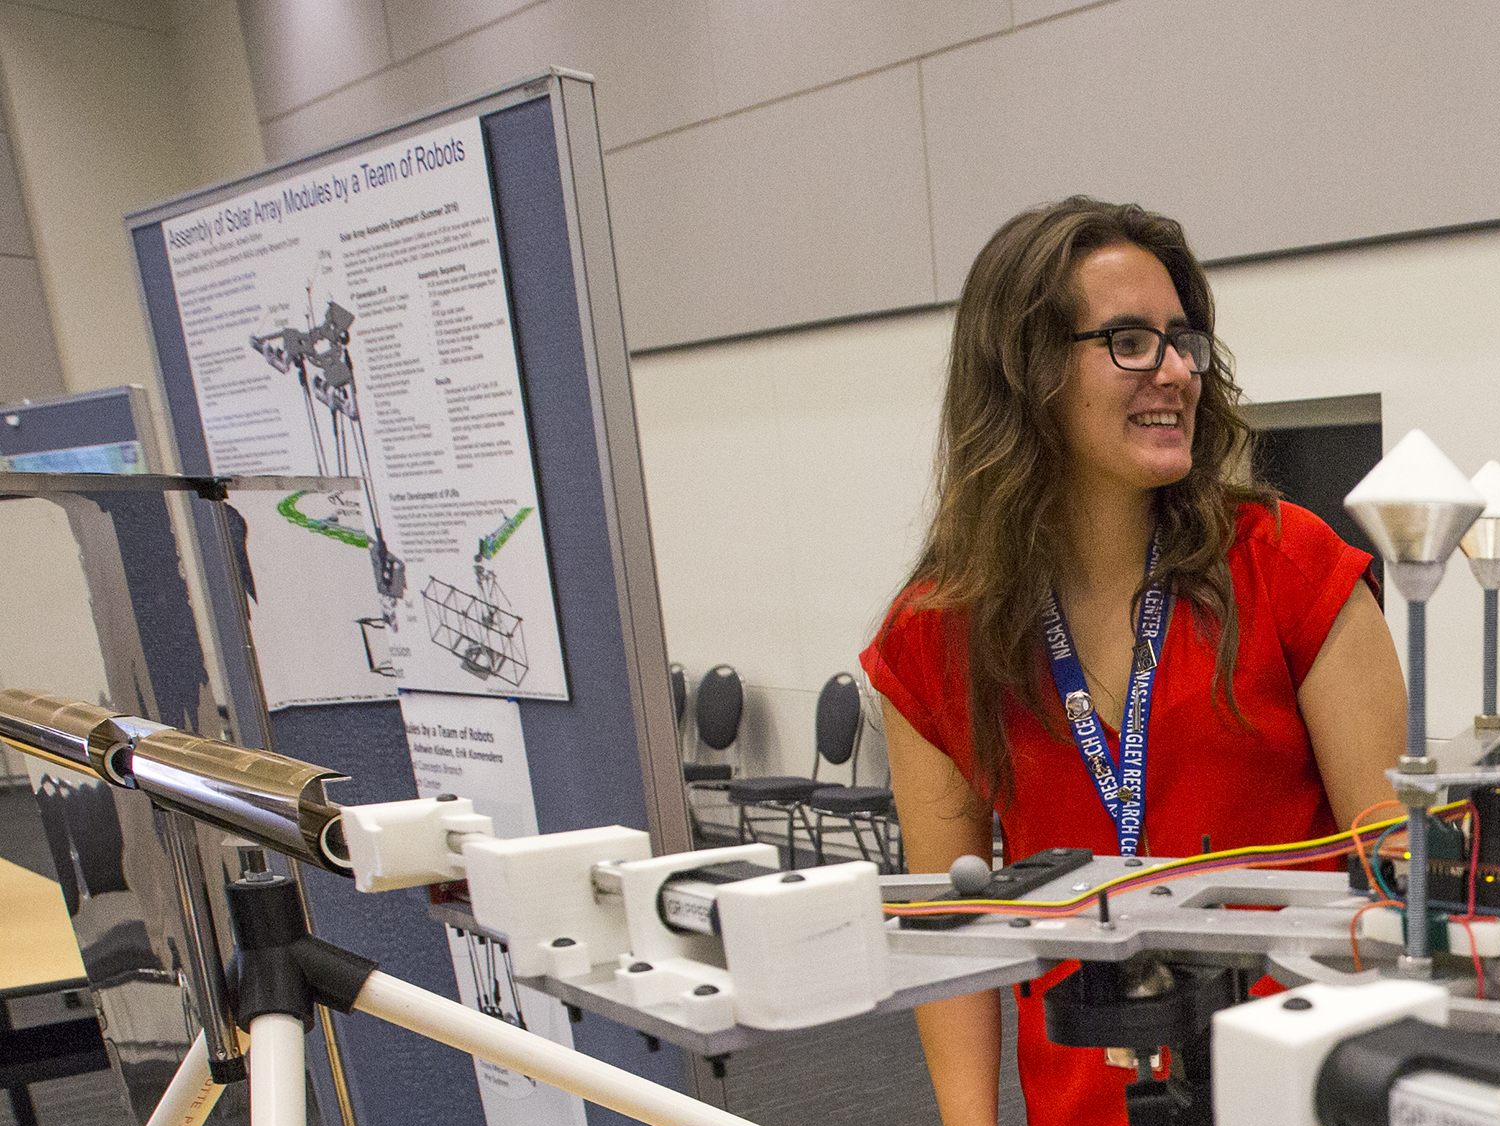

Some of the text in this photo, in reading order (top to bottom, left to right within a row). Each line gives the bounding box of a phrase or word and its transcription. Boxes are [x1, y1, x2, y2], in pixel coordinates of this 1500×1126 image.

[169, 217, 213, 250] Assembly
[214, 211, 225, 236] of
[225, 207, 252, 232] Solar
[254, 198, 283, 224] Array
[283, 181, 332, 214] Modules
[333, 174, 349, 203] by
[352, 174, 360, 193] a
[360, 163, 398, 190] Team
[400, 149, 414, 179] of
[414, 138, 466, 174] Robots
[1047, 624, 1071, 660] NASA
[437, 724, 458, 739] Team
[459, 726, 467, 740] of
[468, 727, 495, 743] Robots
[1081, 736, 1118, 800] RESECH
[1122, 769, 1141, 834] RESEARCH
